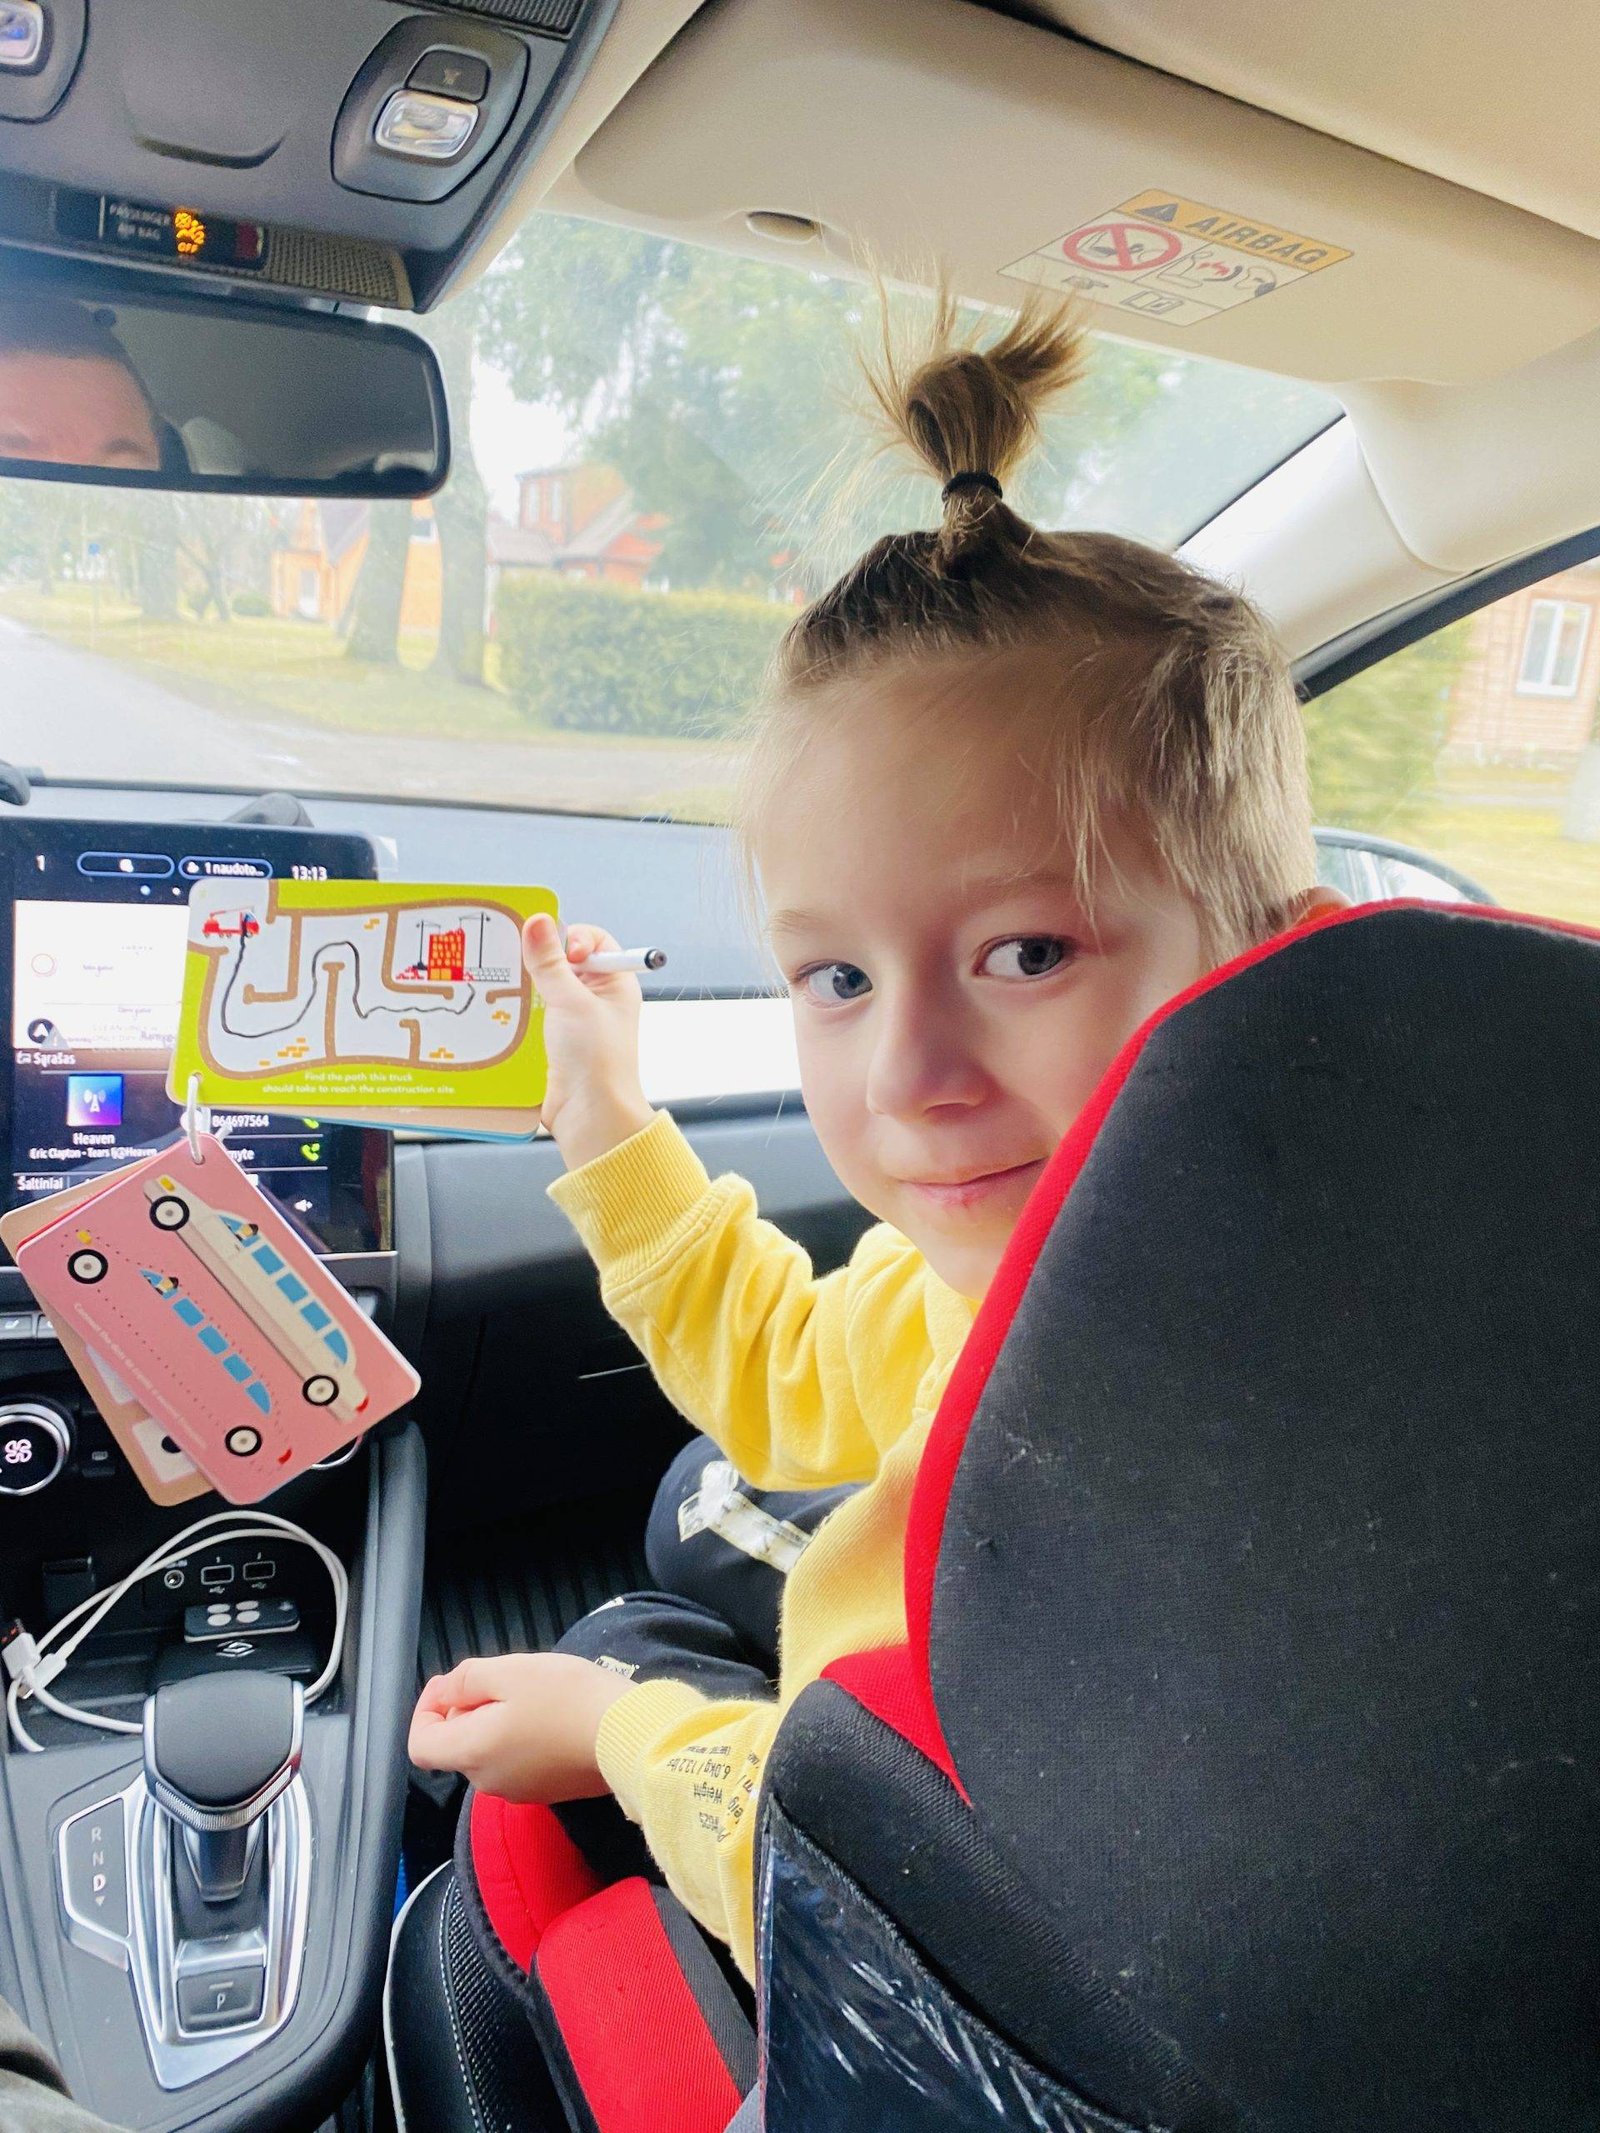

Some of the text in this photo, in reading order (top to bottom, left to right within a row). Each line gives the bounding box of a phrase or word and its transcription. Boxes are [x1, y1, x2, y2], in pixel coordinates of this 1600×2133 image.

[1184, 216, 1328, 265] AIRBAG
[291, 865, 329, 881] 13:13
[304, 1072, 413, 1084] Find the path this truck
[262, 1084, 294, 1094] should
[318, 1084, 328, 1093] to
[330, 1084, 357, 1094] reach
[359, 1084, 374, 1094] the
[376, 1084, 433, 1094] construction
[72, 1131, 116, 1146] Heaven
[29, 1147, 47, 1159] Eric
[48, 1148, 81, 1160] Clayton
[87, 1147, 110, 1159] Tears
[693, 1781, 723, 1804] Weight
[91, 1826, 102, 1843] R
[92, 1851, 104, 1866] N
[93, 1873, 106, 1892] D
[216, 1991, 226, 2011] P
